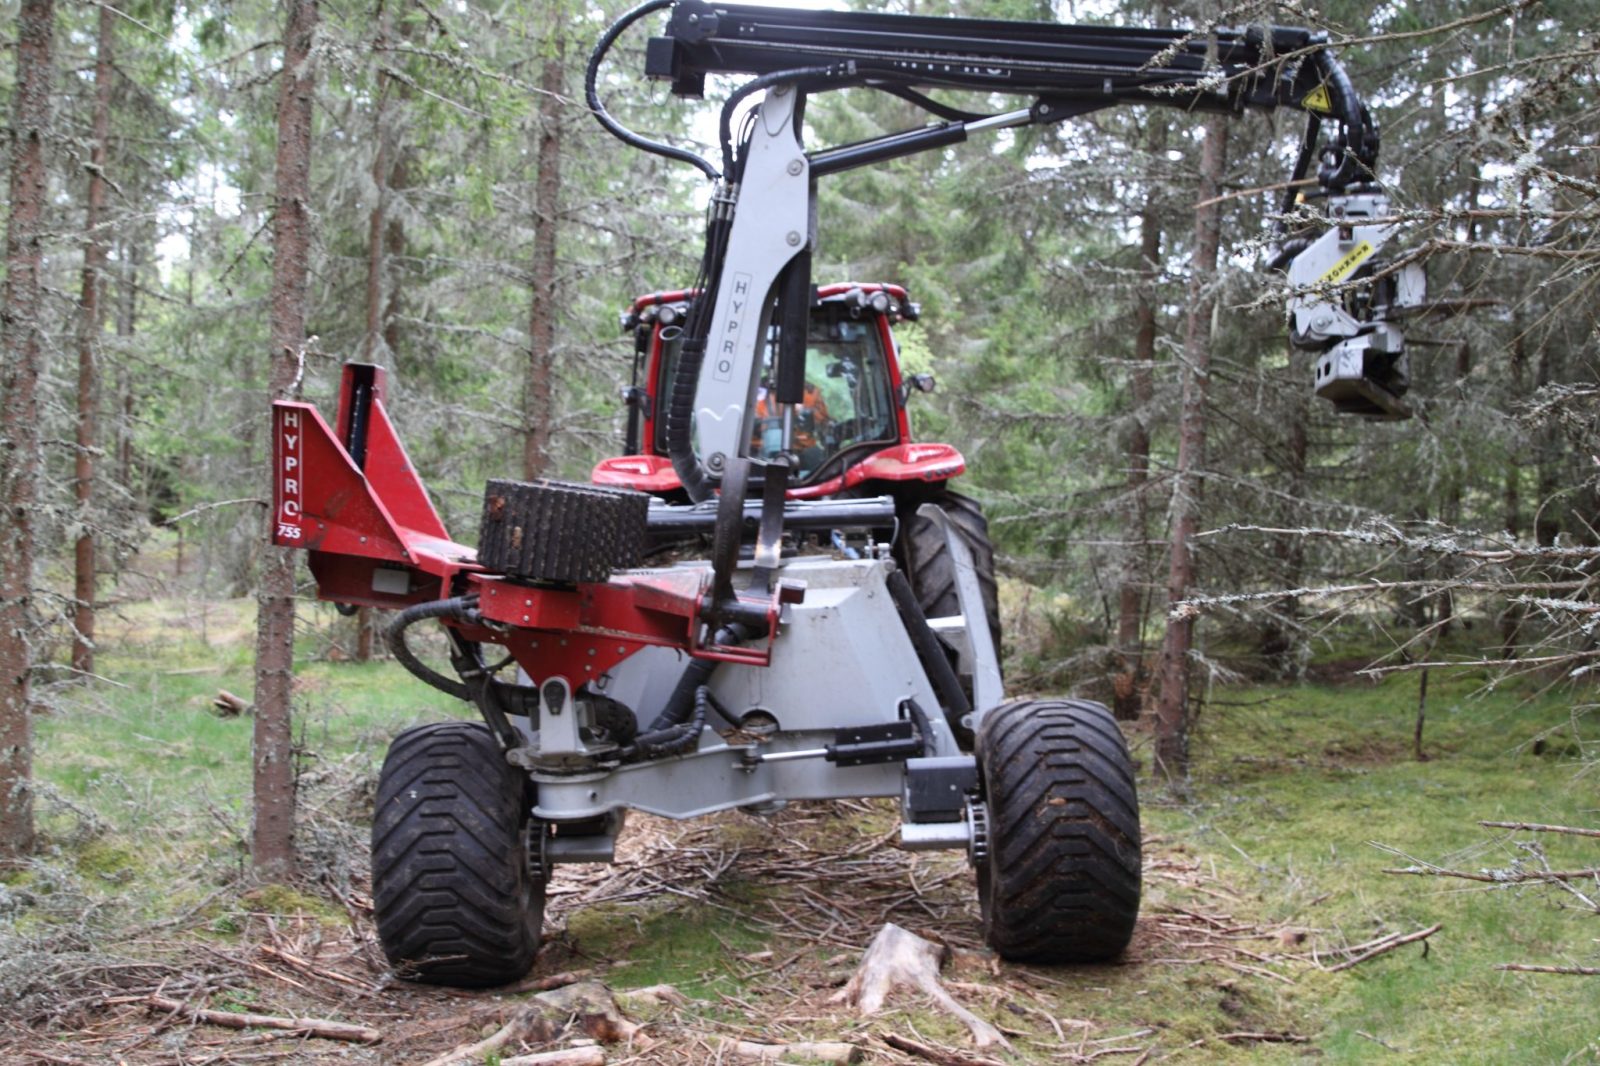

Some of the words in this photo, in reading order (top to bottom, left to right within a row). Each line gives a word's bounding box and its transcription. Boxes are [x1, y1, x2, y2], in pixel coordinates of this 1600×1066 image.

[718, 280, 747, 373] HYPRO
[284, 412, 299, 516] HYPRO
[277, 525, 301, 539] 755
